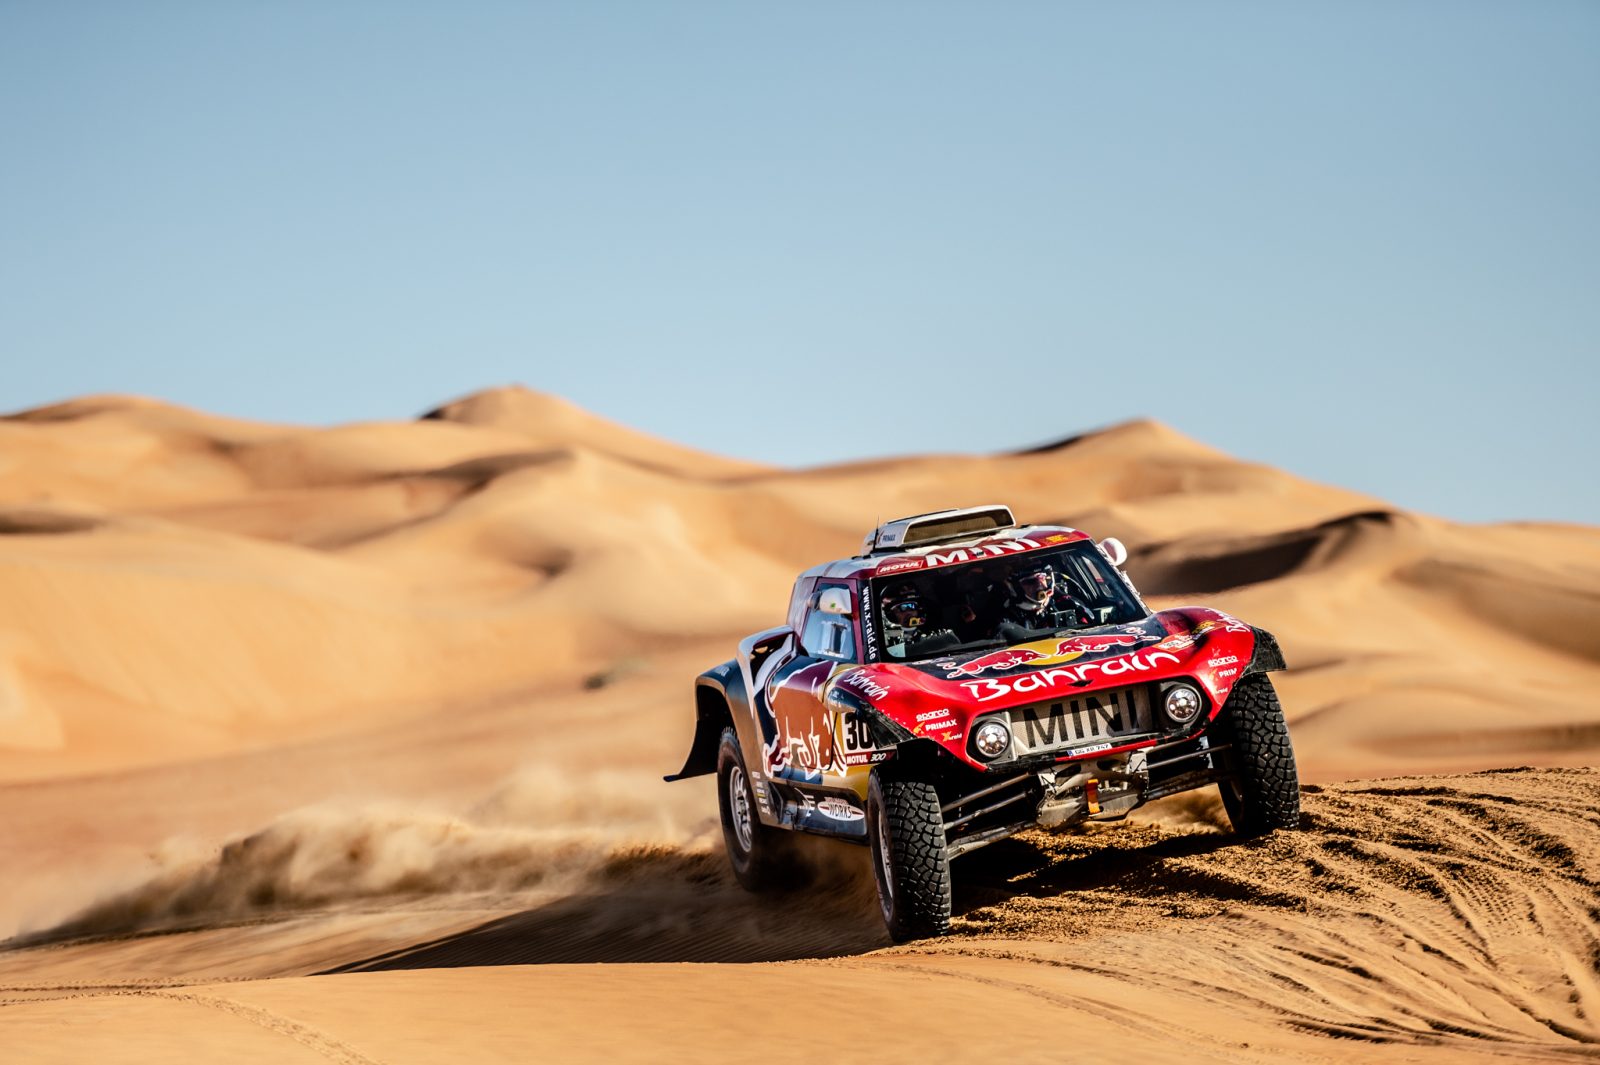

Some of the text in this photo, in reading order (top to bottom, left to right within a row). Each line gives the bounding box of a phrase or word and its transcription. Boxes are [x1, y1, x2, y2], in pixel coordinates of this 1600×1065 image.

[925, 538, 1042, 567] MINI
[879, 562, 921, 573] MOTUL
[862, 585, 878, 660] www.x-raid.de
[959, 650, 1181, 702] Bahrain
[916, 708, 950, 722] sparco
[1022, 689, 1140, 749] MINI
[925, 719, 957, 731] PRIMAX
[846, 753, 868, 764] MOTUL
[828, 803, 853, 819] WORKS
